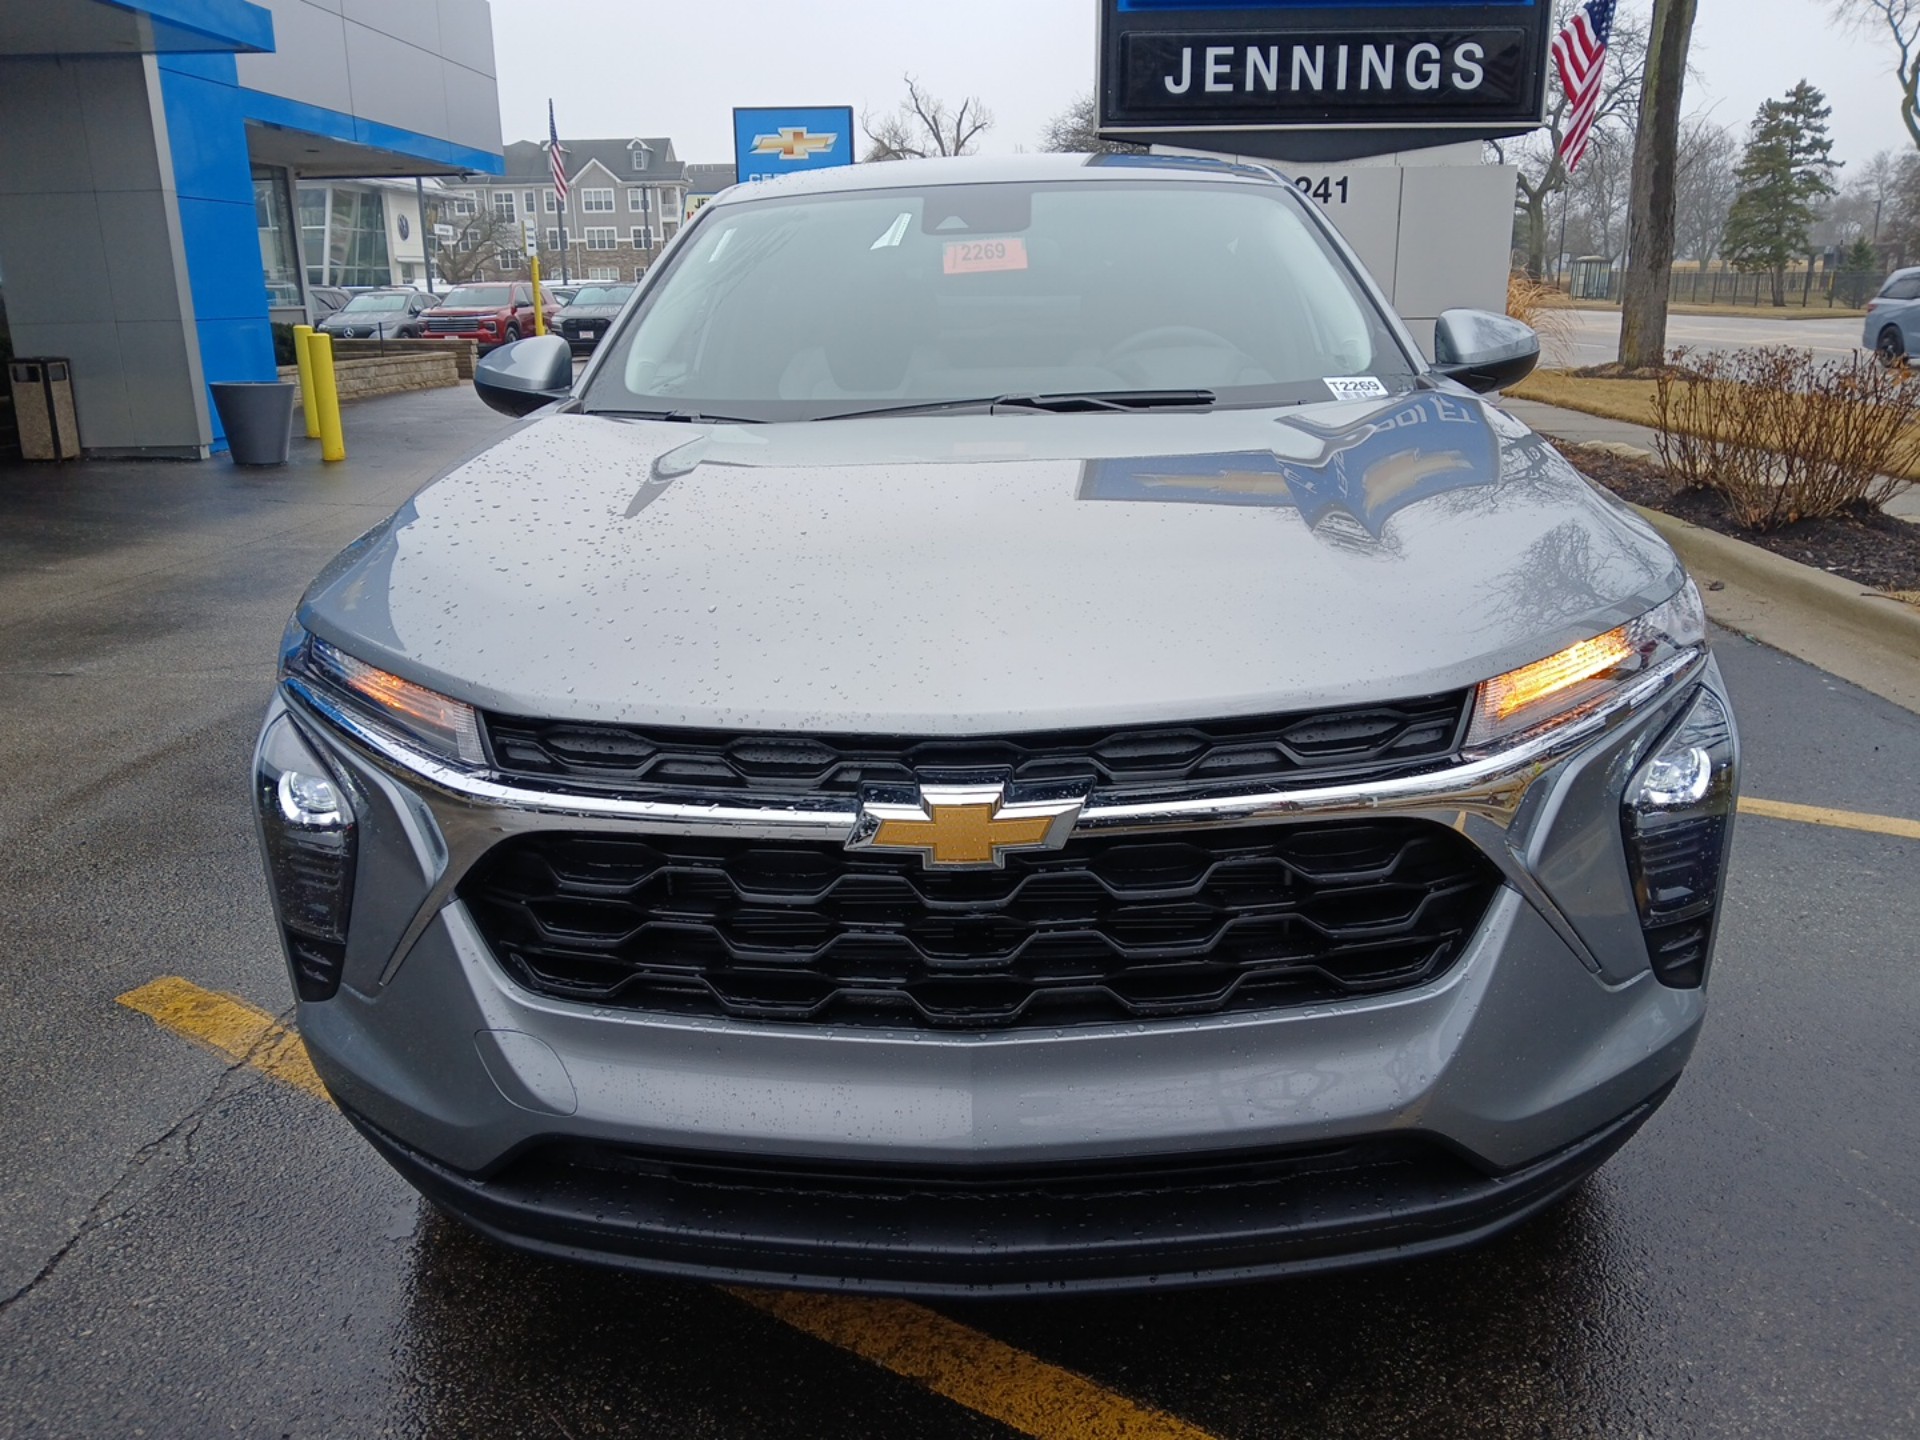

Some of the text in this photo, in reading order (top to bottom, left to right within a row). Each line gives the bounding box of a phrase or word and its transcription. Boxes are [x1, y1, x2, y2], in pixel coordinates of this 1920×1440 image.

[1164, 42, 1485, 94] JENNINGS
[1294, 175, 1349, 204] 241
[1328, 380, 1380, 391] T2269
